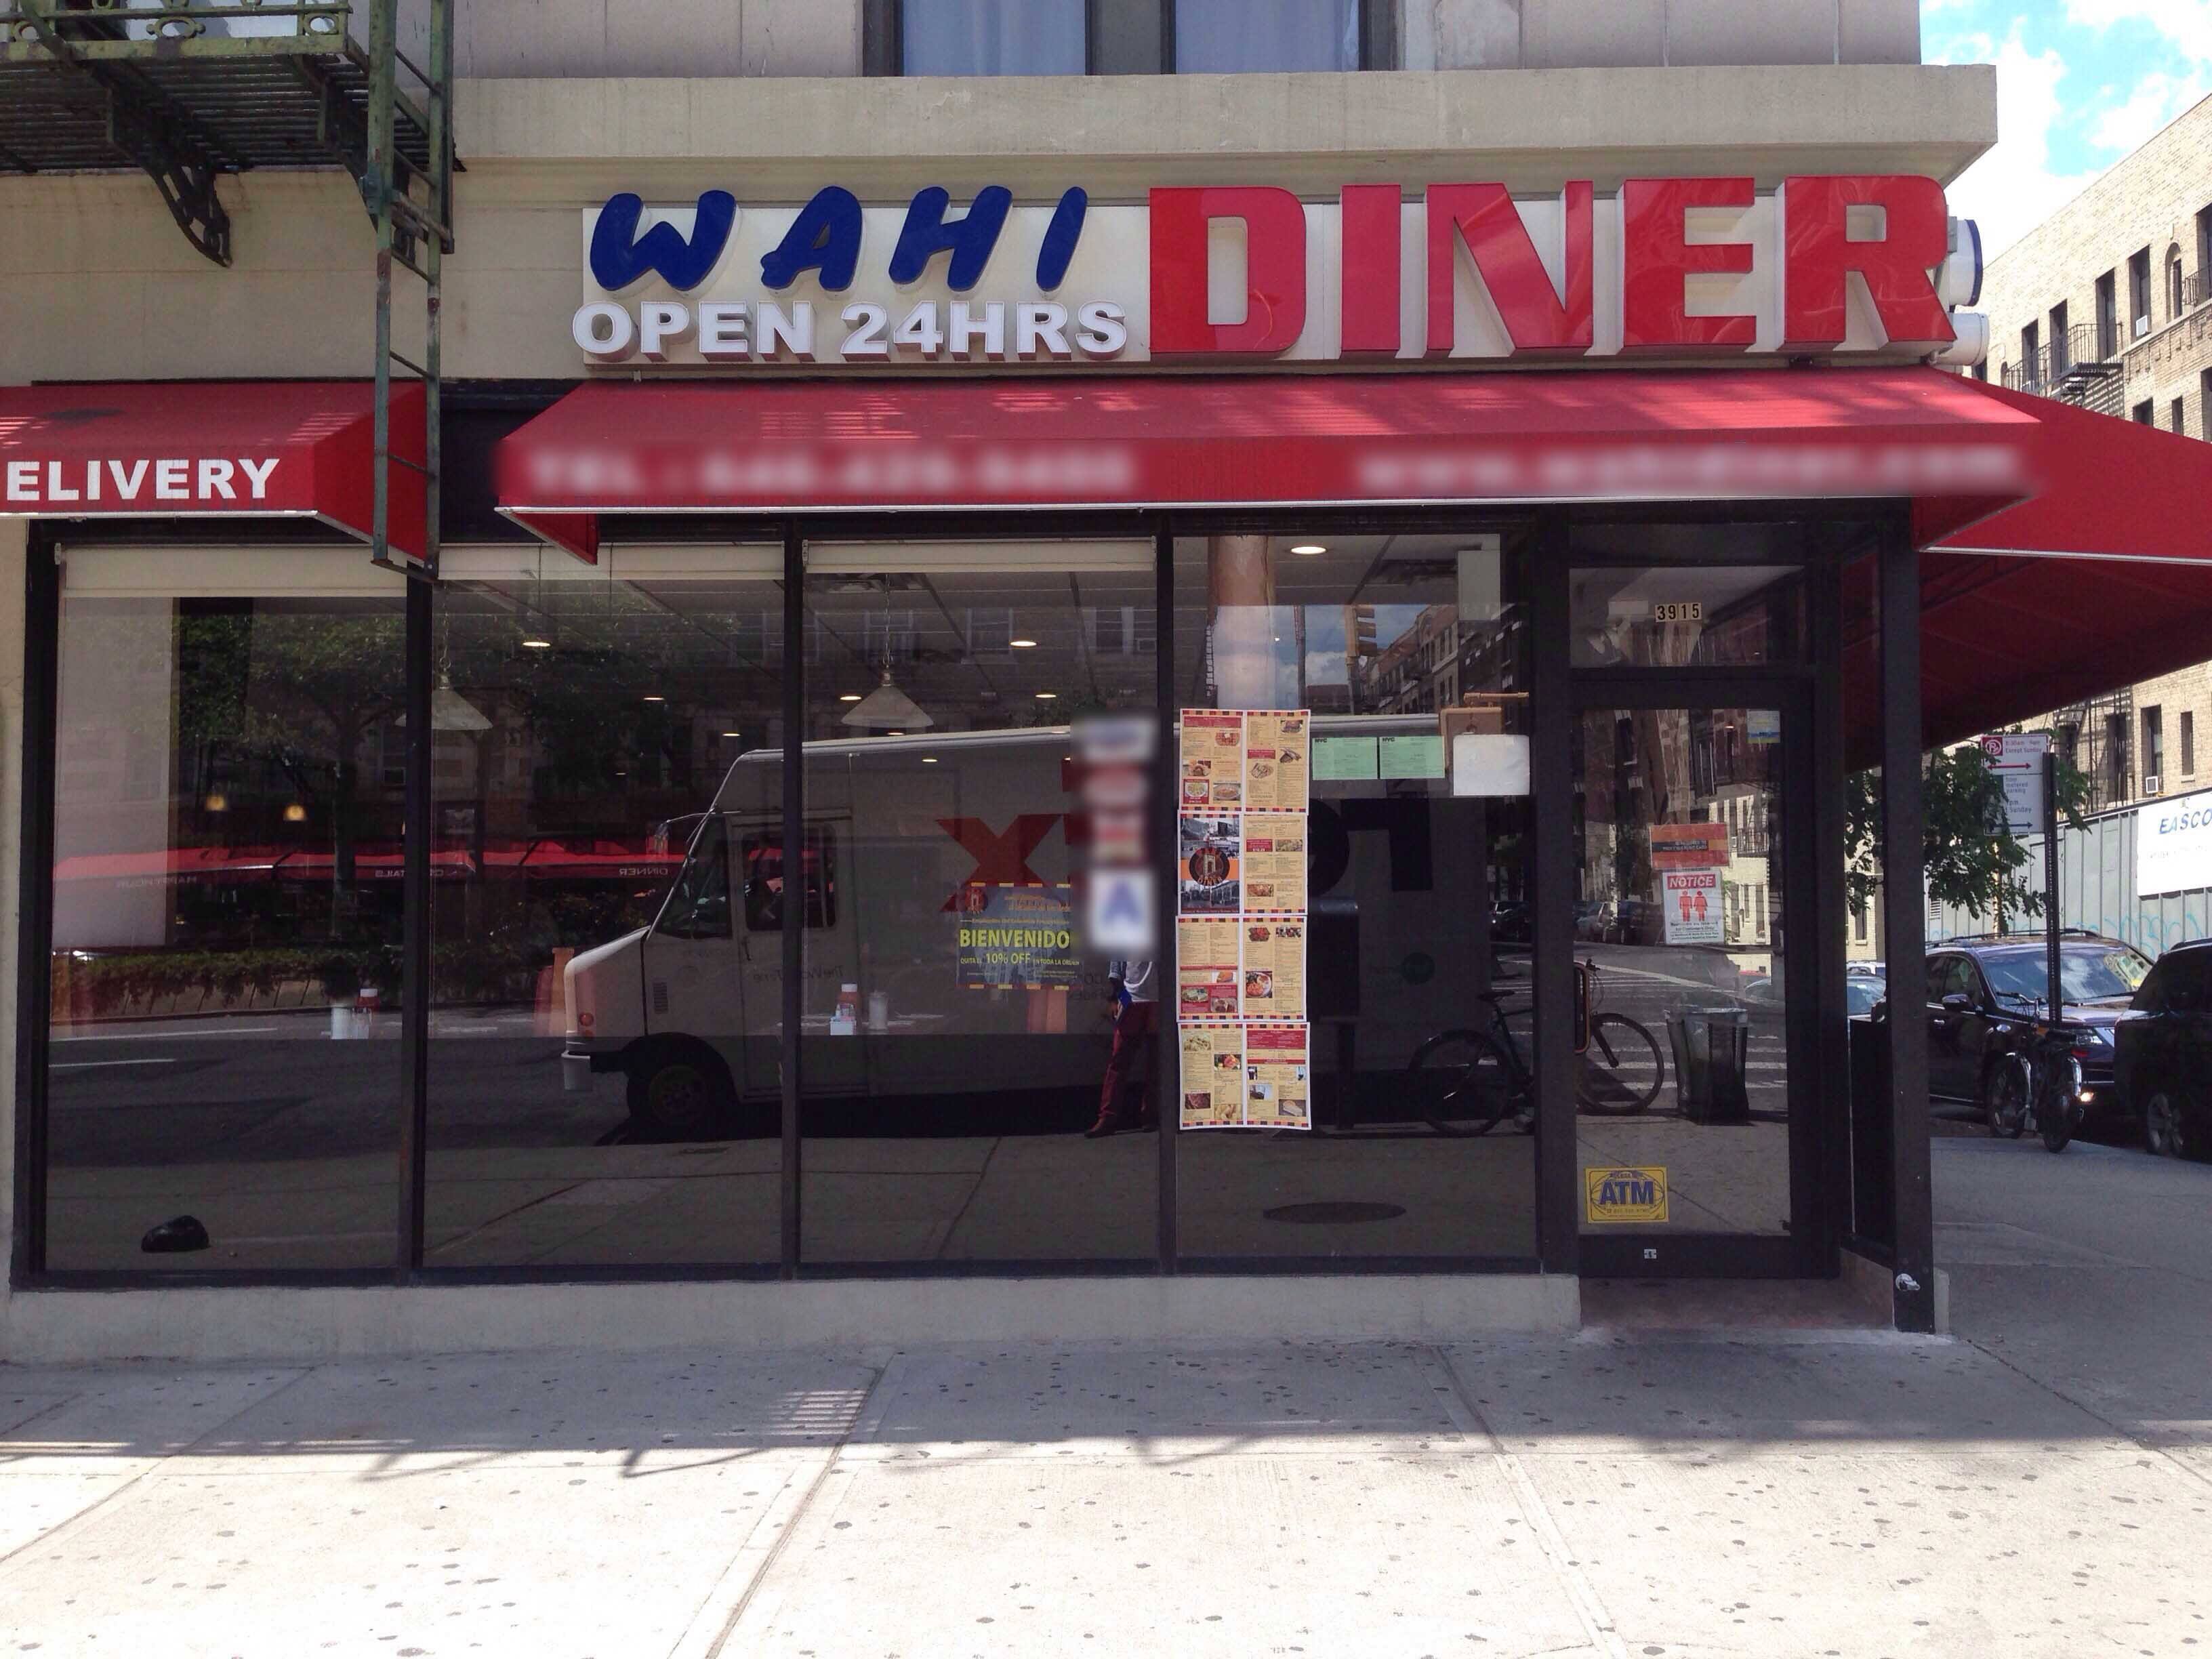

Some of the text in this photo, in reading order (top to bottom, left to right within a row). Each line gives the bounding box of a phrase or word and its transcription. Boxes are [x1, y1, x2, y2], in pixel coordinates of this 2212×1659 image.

[589, 186, 1089, 295] WAHI
[1149, 175, 1957, 358] DINER
[572, 300, 1128, 362] OPEN 24HRS
[6, 458, 281, 502] ELIVERY
[1657, 602, 1700, 621] 3915
[1669, 876, 1715, 888] NOTICE
[985, 953, 1008, 964] 10%
[1010, 953, 1031, 965] OFF
[1599, 1181, 1655, 1205] ATM
